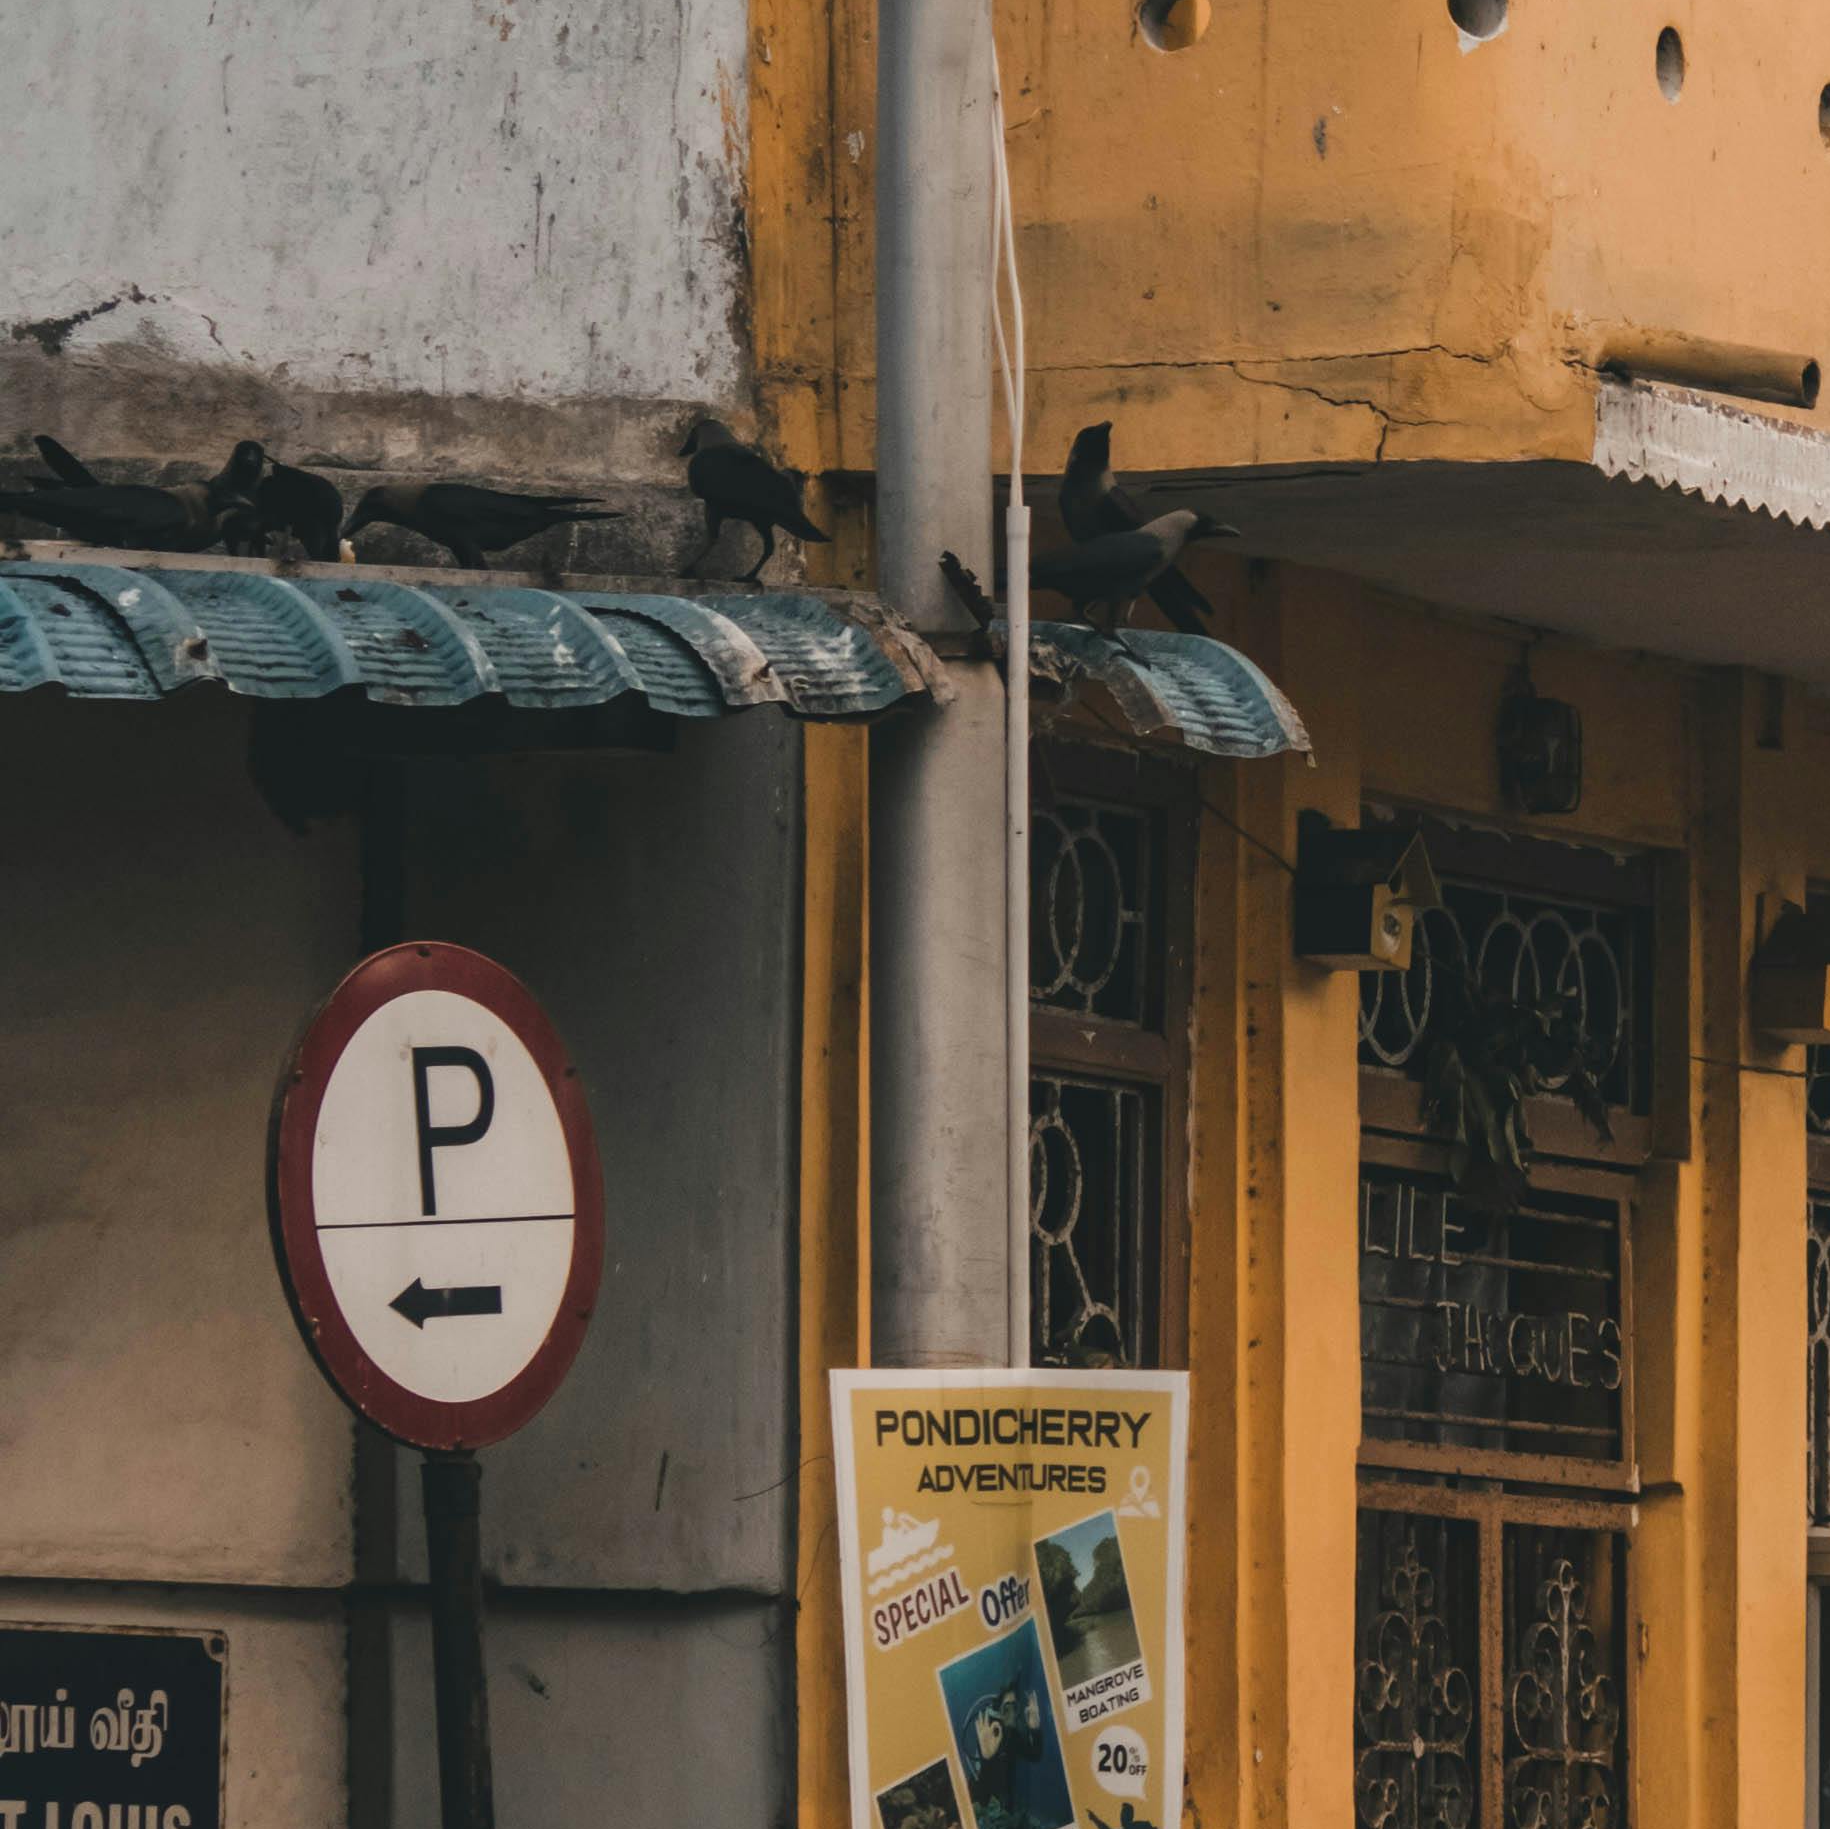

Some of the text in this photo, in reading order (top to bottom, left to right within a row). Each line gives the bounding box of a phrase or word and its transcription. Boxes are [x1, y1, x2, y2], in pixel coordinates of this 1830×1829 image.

[412, 1046, 495, 1216] P
[875, 1408, 1152, 1449] PONDICHERRY
[916, 1463, 1107, 1494] ADVENTURES
[874, 1571, 1031, 1646] SPECIAL Offer
[1066, 1663, 1145, 1707] MANGROVE
[1079, 1687, 1140, 1724] BOATING
[90, 1687, 169, 1768] வீதி
[1128, 1764, 1148, 1776] OFF
